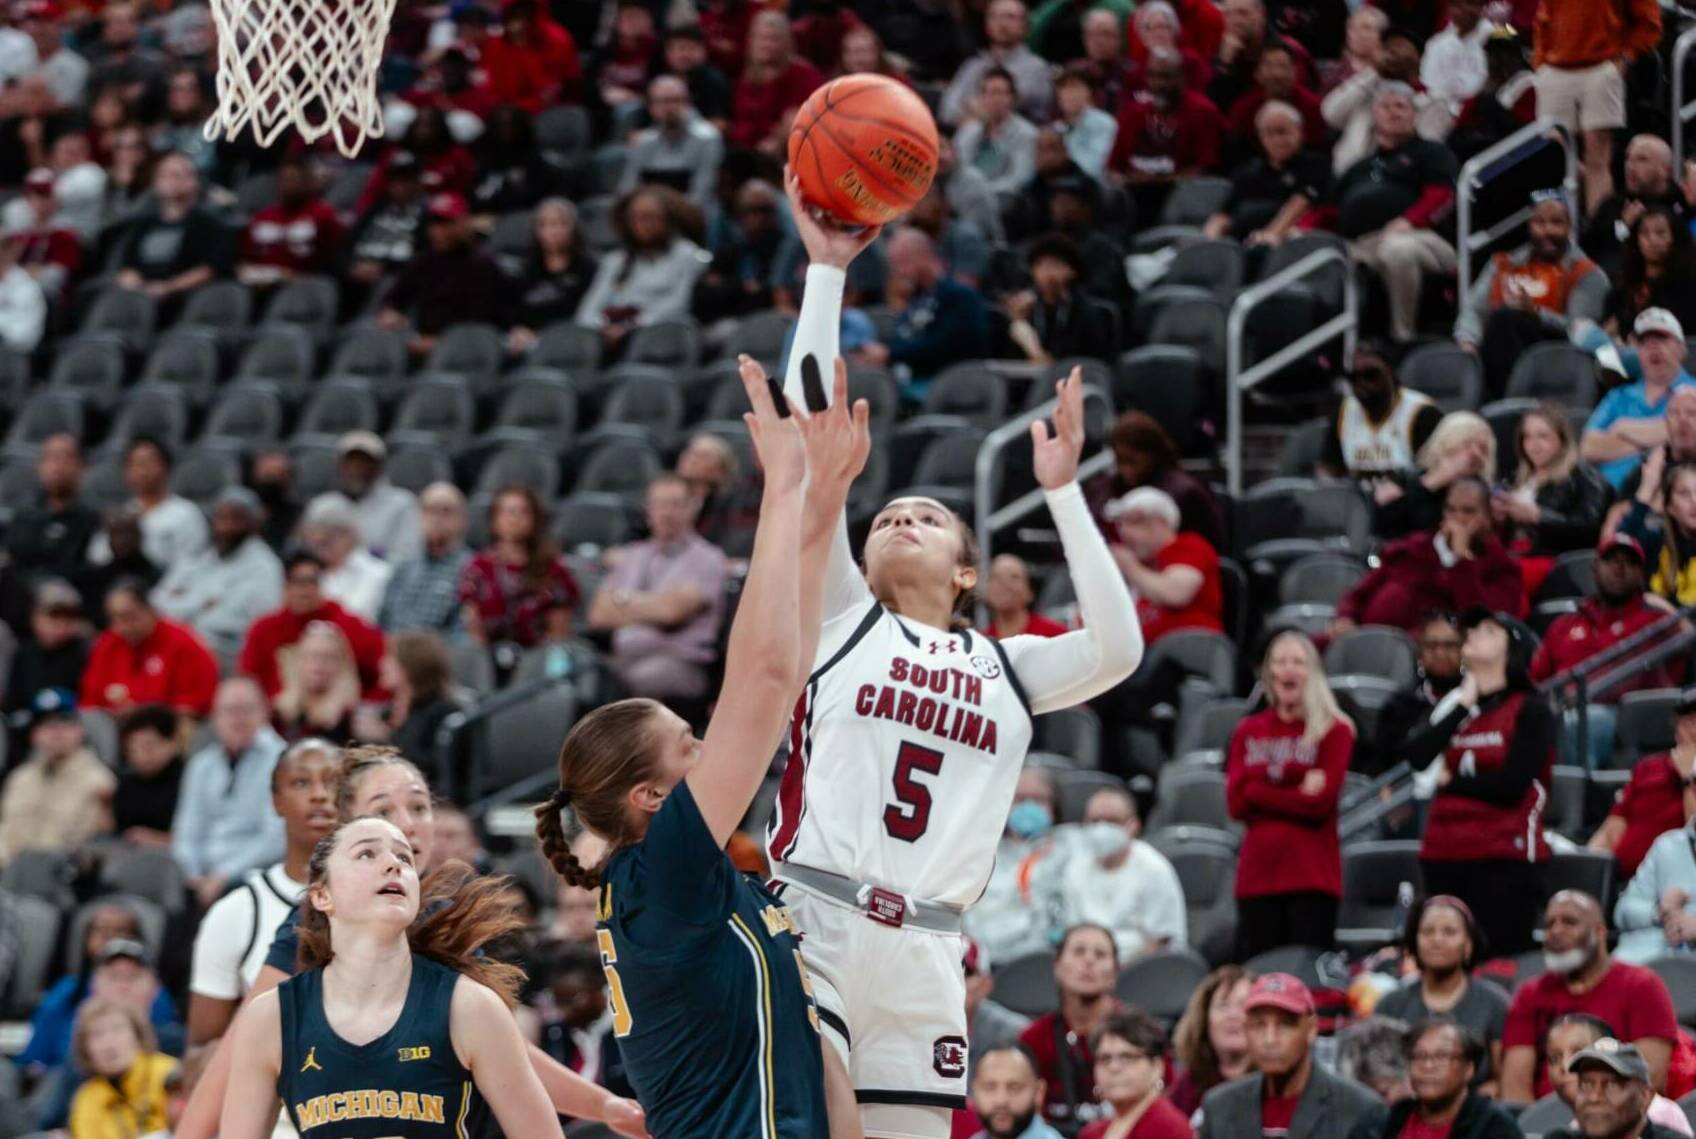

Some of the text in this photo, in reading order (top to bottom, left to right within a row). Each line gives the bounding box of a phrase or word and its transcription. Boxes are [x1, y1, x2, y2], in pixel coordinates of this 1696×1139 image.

[889, 656, 982, 706] SOUTH
[855, 684, 998, 755] CAROLINA
[883, 739, 945, 843] 5
[296, 1089, 445, 1132] MICHIGAN
